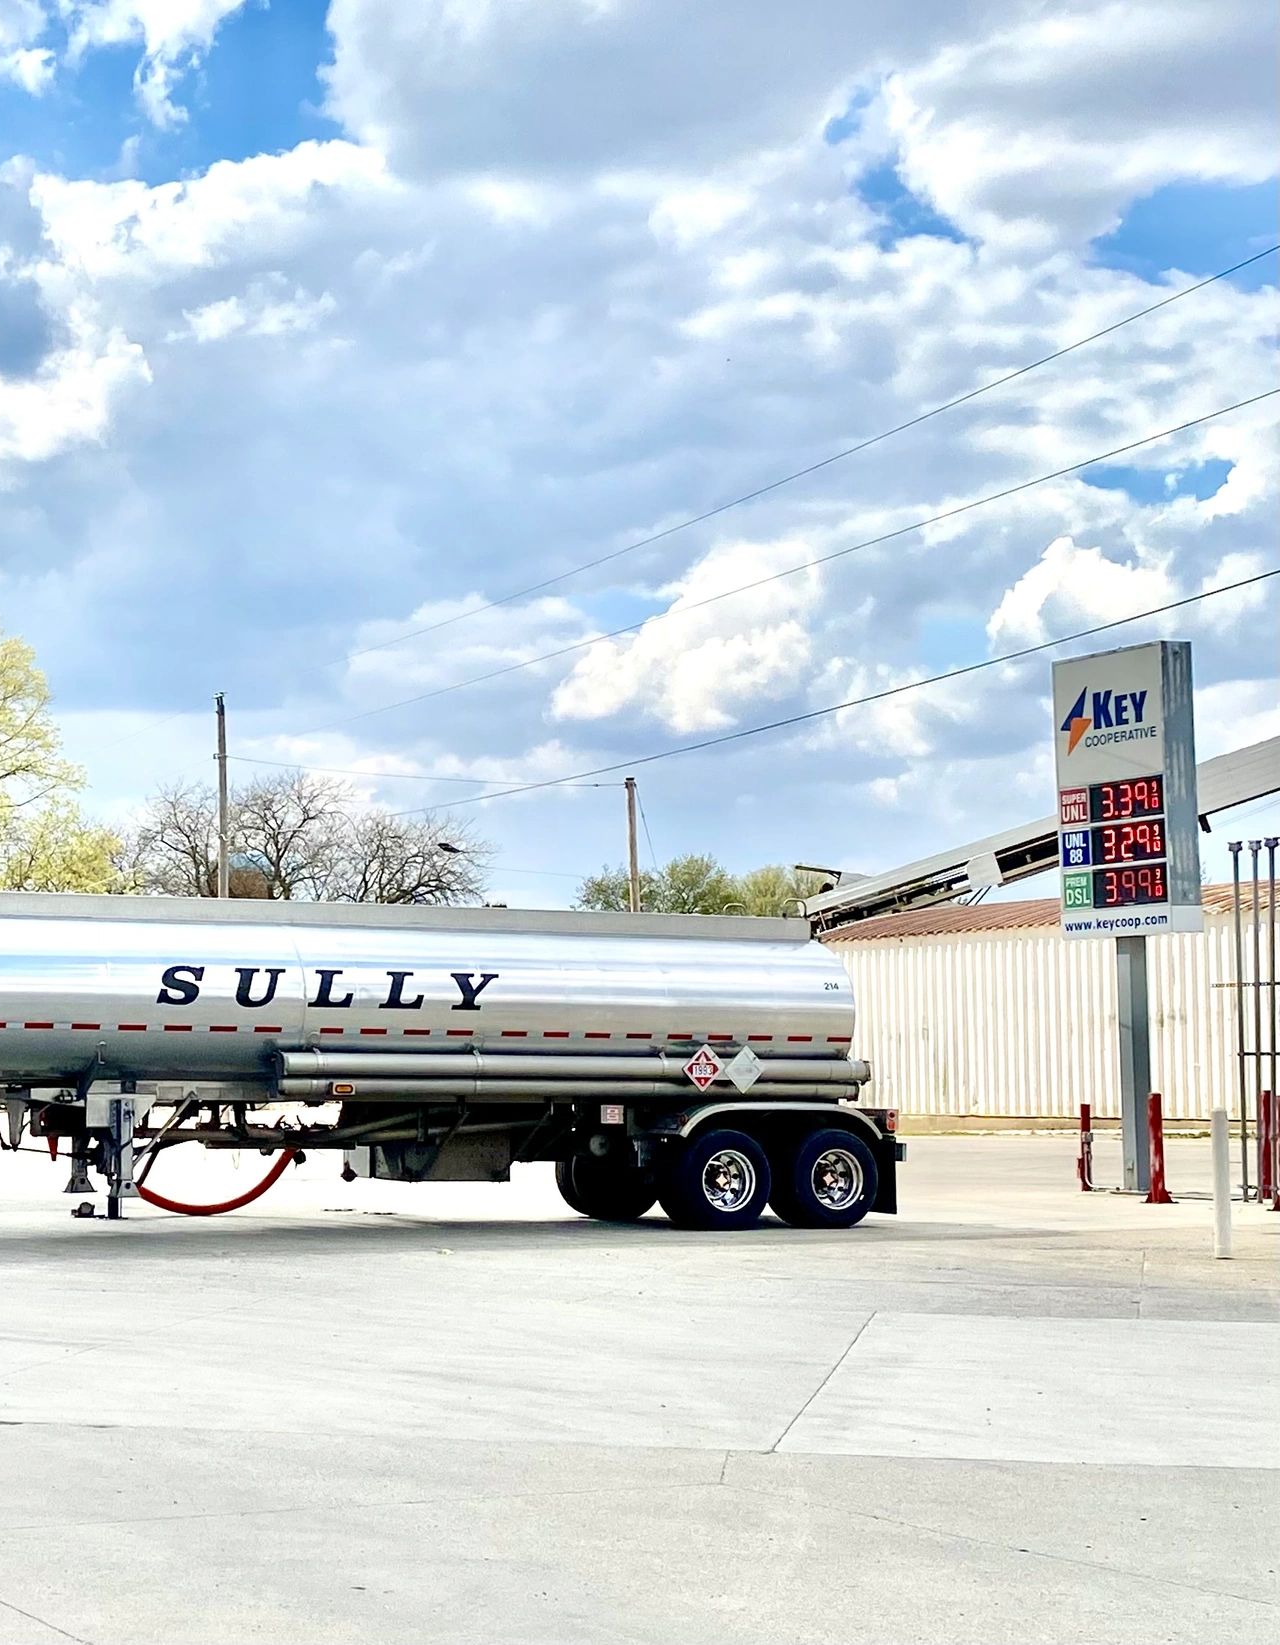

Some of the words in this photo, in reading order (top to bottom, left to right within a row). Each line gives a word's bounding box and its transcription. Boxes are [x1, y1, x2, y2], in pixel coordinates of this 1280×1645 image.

[1092, 690, 1148, 730] KEY
[1085, 726, 1157, 748] COOPERATIVE
[1062, 792, 1087, 805] SUPER
[1062, 803, 1087, 822] UNL
[1065, 832, 1087, 849] UNL
[1069, 848, 1083, 864] 88
[1065, 876, 1088, 888] PREM
[1066, 887, 1091, 905] DSL
[1065, 915, 1168, 931] www.keycoop.com
[156, 965, 499, 1011] SULLY
[824, 982, 840, 991] 214
[693, 1064, 714, 1076] 1993
